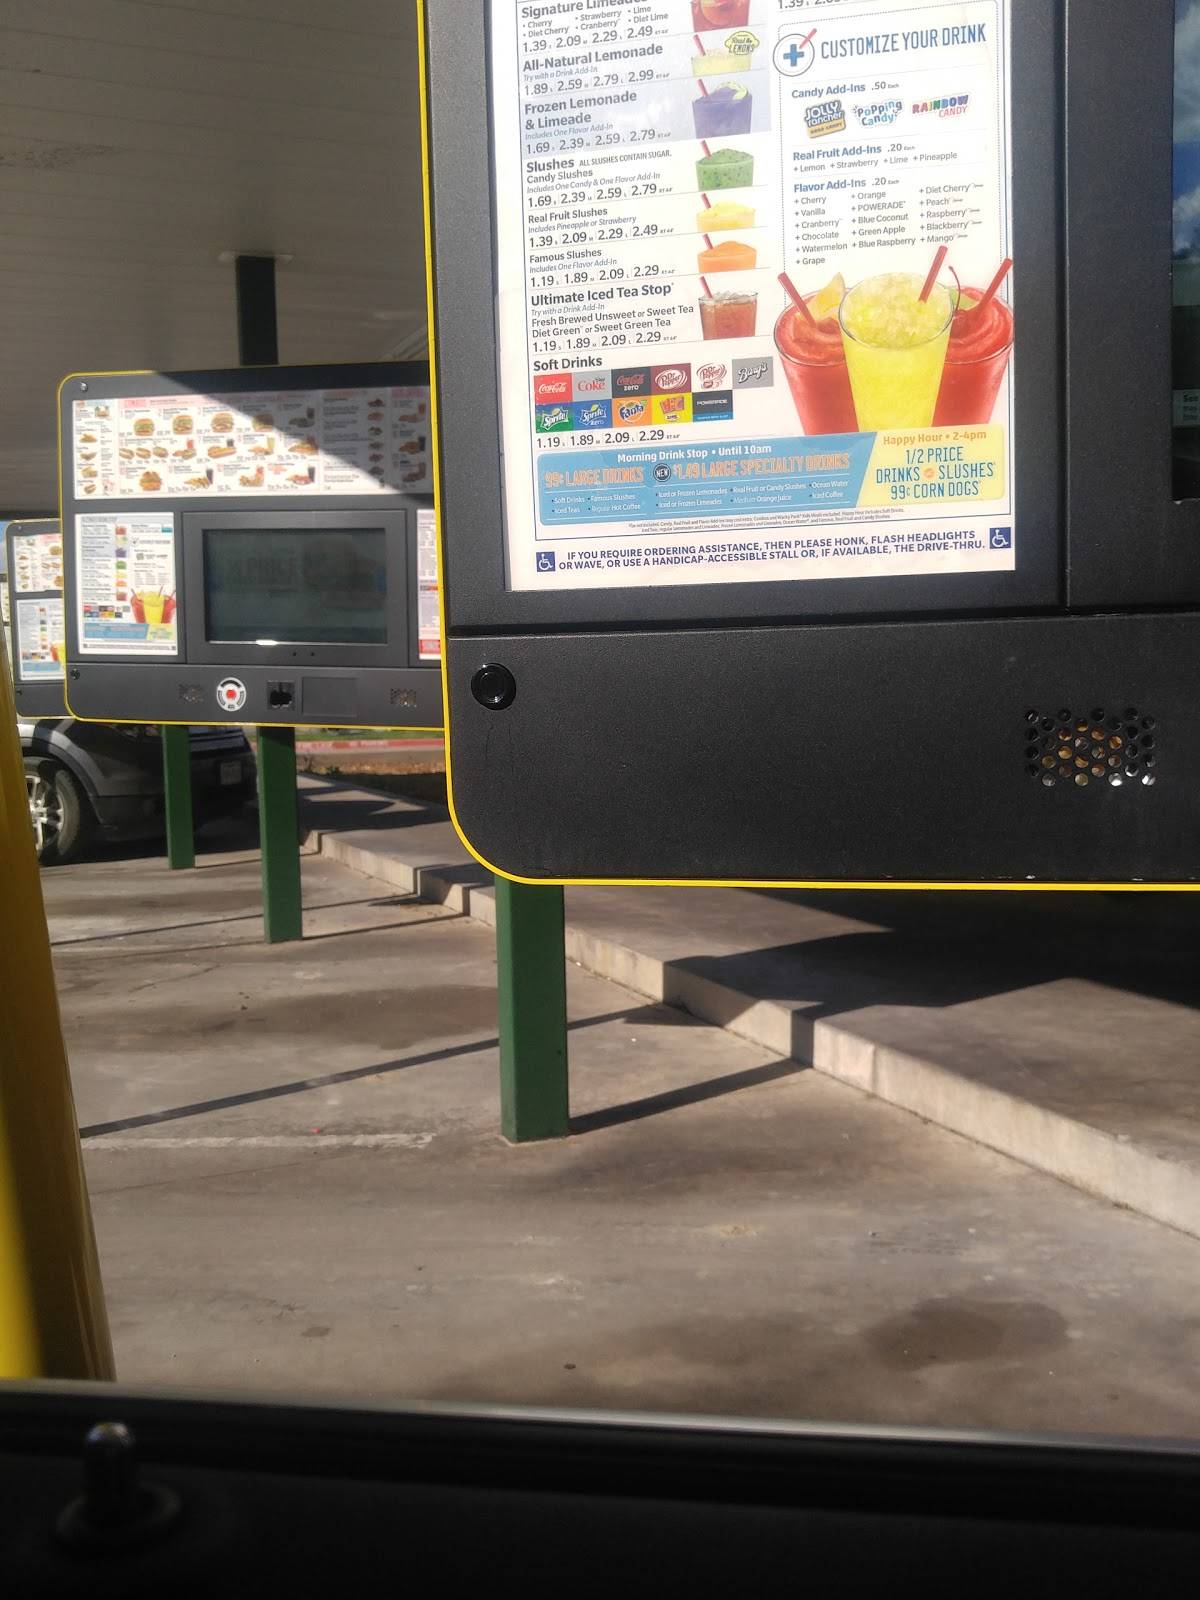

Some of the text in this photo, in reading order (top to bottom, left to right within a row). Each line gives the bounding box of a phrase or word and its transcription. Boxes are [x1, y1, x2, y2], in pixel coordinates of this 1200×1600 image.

[521, 1, 583, 19] Signature
[592, 29, 617, 43] 2.29
[627, 25, 653, 38] 2.49
[523, 39, 547, 52] 1.39
[556, 34, 581, 48] 2.09
[821, 23, 986, 59] CUSTOMIZE YOUR DRINK
[522, 43, 663, 72] All-Natural Lemonade
[593, 73, 618, 86] 2.79
[628, 69, 654, 82] 2.99
[524, 82, 548, 95] 1.89
[557, 78, 582, 91] 2.59
[791, 83, 865, 98] Candy Add-Ins
[871, 81, 886, 90] .50
[524, 90, 636, 115] Frozen Lemonade
[912, 95, 968, 114] RAINBOW
[858, 101, 902, 118] Popping
[939, 106, 968, 118] CANDY
[525, 112, 591, 130] & Limeade
[862, 114, 895, 126] Candy
[595, 133, 620, 145] 2.59
[630, 128, 655, 141] 2.79
[527, 141, 550, 154] 1.69
[559, 137, 584, 150] 2.39
[887, 143, 902, 152] .20
[619, 152, 647, 161] CONTAIN
[648, 149, 672, 158] SUGAR.
[793, 145, 881, 160] Real Fruit Add-Ins
[919, 151, 957, 161] Pineapple
[526, 158, 574, 173] Slushes
[800, 164, 825, 172] Lemon
[836, 159, 878, 168] Strawberry
[526, 169, 593, 183] Candy Slushes
[871, 176, 886, 185] .20
[631, 183, 656, 196] 2.79
[794, 179, 866, 192] Flavor Add-Ins
[925, 184, 970, 194] Diet Cherry
[560, 191, 585, 204] 2.39
[596, 187, 621, 200] 2.59
[800, 196, 826, 204] Cherry
[857, 191, 886, 199] Orange
[528, 195, 551, 207] 1.69
[528, 207, 607, 223] Real Fruit Slushes
[800, 207, 825, 216] Vanilla
[875, 213, 908, 222] Coconut
[598, 228, 622, 240] 2.29
[632, 224, 658, 236] 2.49
[801, 231, 839, 240] Chocolate
[882, 225, 905, 235] Apple
[529, 235, 552, 247] 1.39
[562, 231, 586, 244] 2.09
[801, 242, 847, 252] Watermelon
[529, 249, 601, 263] Famous Slushes
[802, 257, 825, 265] Grape
[599, 268, 624, 280] 2.09
[633, 264, 659, 277] 2.29
[530, 275, 554, 287] 1.19
[564, 271, 588, 284] 1.89
[531, 284, 671, 306] Ultimate Iced Tea Stop
[531, 316, 556, 327] Fresh
[558, 313, 593, 324] Brewed
[595, 310, 636, 321] Unsweet
[646, 306, 675, 316] Sweet
[677, 304, 693, 313] Tea
[532, 328, 550, 338] Diet
[552, 325, 580, 336] Green
[594, 322, 622, 332] Sweet
[624, 321, 652, 329] Green
[654, 318, 671, 326] Tea
[567, 337, 590, 349] 1.89
[601, 334, 626, 346] 2.09
[635, 331, 661, 343] 2.29
[532, 340, 556, 352] 1.19
[533, 355, 602, 371] Soft Drinks
[539, 382, 567, 394] Coca-Cola
[578, 380, 605, 392] Coke
[619, 404, 643, 420] Fanta
[543, 413, 566, 426] Sprite
[570, 434, 593, 446] 1.89
[604, 431, 629, 443] 2.09
[639, 429, 664, 441] 2.29
[883, 434, 942, 446] Happy Hour
[952, 431, 986, 441] 2-4pm
[536, 436, 560, 448] 1.19
[617, 449, 708, 462] Morning Drink Stop
[718, 444, 771, 455] Until 10am
[905, 446, 964, 464] 1/2 PRICE
[876, 466, 920, 483] DRINKS
[913, 482, 944, 498] CORN
[567, 530, 975, 560] IF YOU REQUIRE ORDERING ASSISTANCE, THEN PLEASE HONK, FLASH HEADLIGHTS
[558, 540, 984, 569] OR WAVE, OR USE A HANDICAP-ACCESSIBLE STALL OR, IF AVAILABLE, THE DRIVE-THRU.
